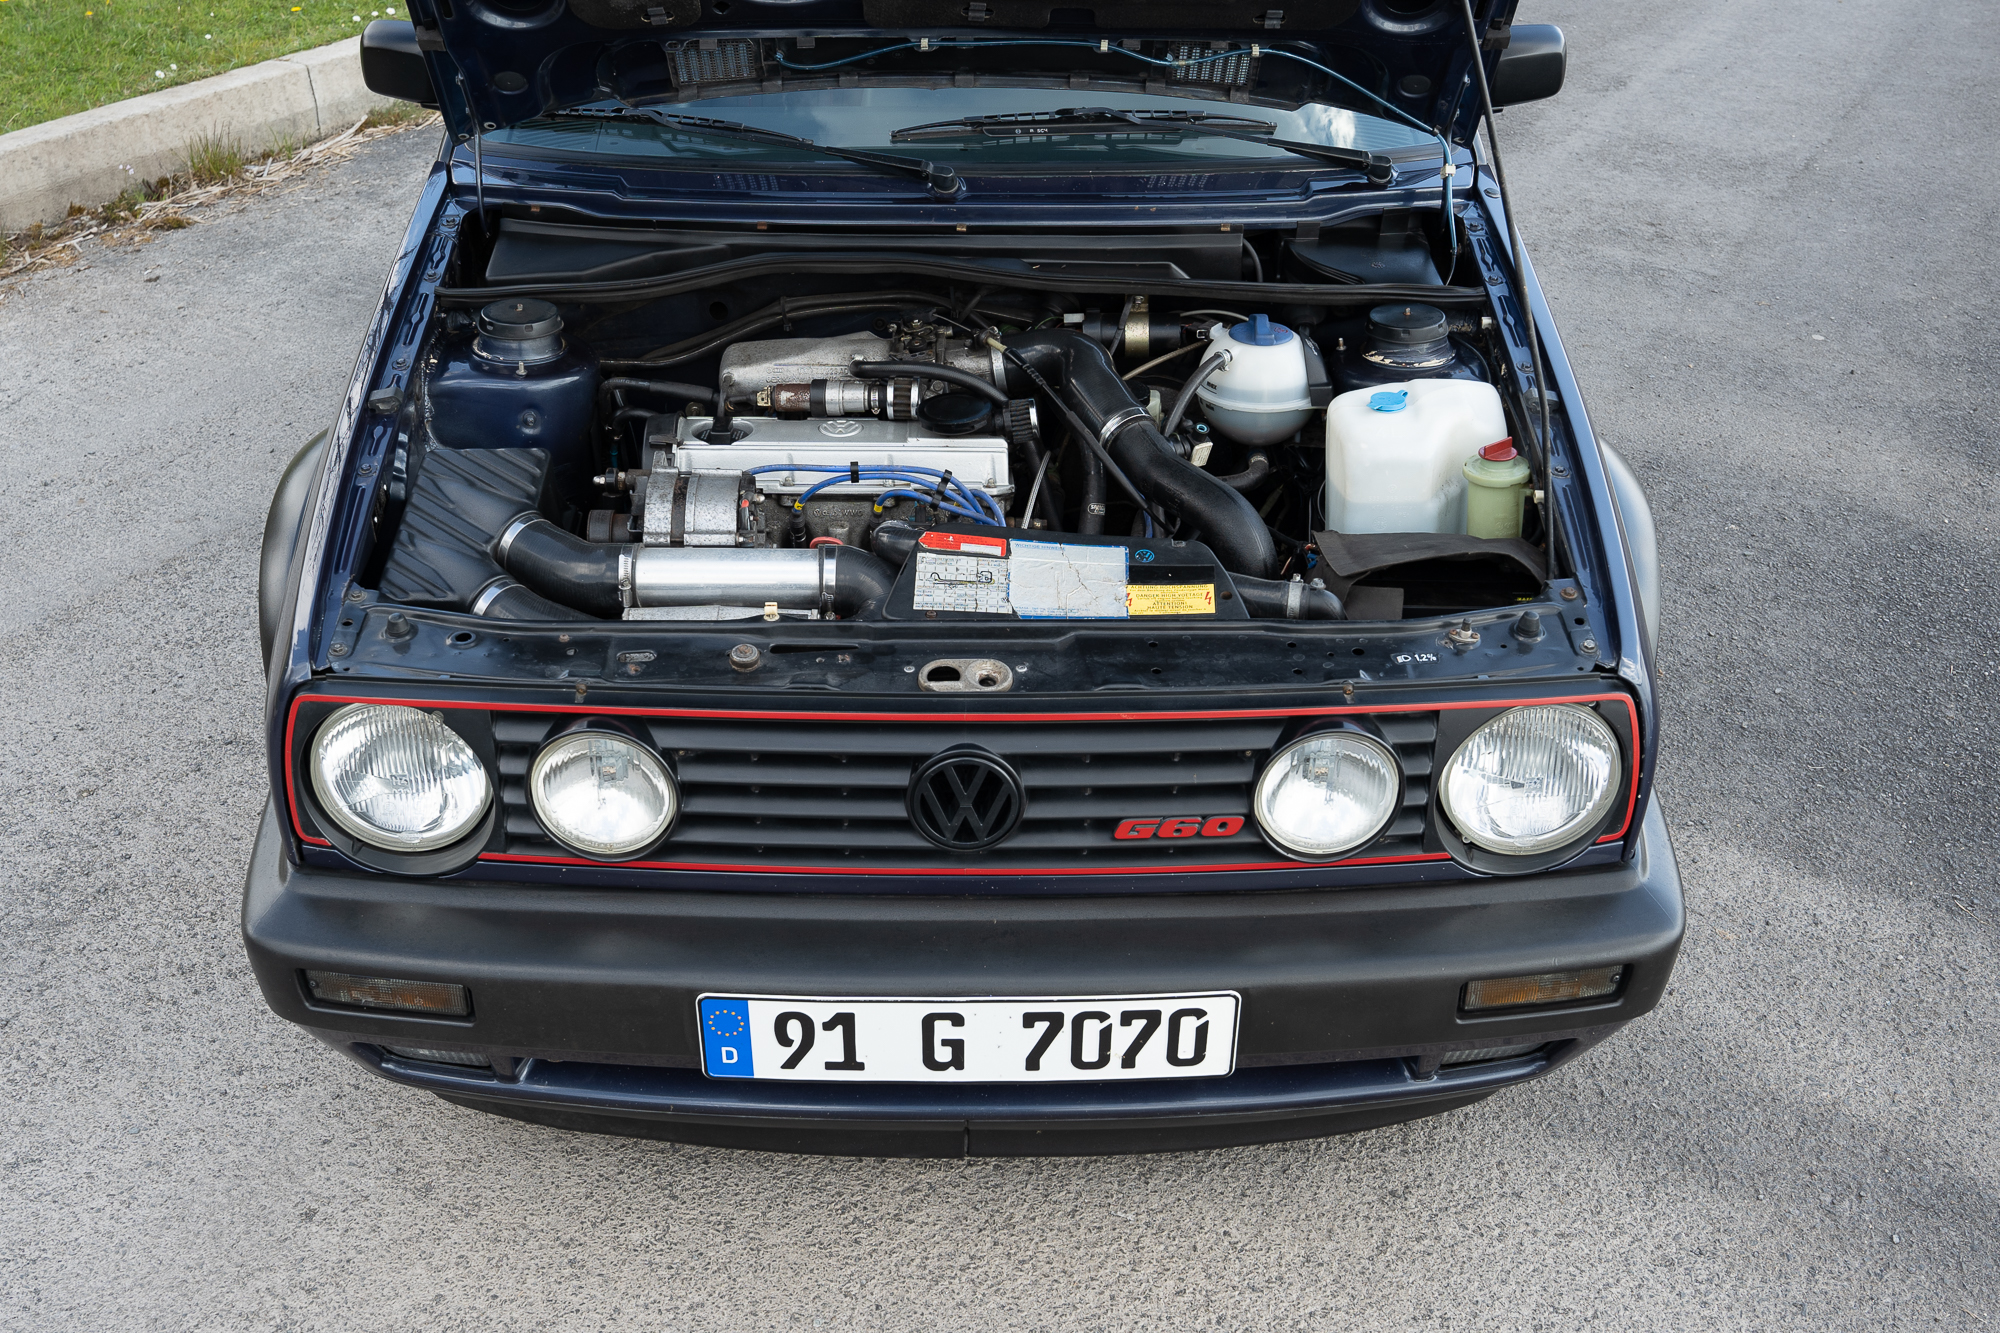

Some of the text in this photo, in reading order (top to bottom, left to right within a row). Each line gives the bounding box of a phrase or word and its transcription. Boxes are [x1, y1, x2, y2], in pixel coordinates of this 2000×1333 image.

[907, 749, 1024, 850] VW
[1113, 815, 1246, 840] G60
[721, 1046, 738, 1064] D
[773, 1007, 1210, 1071] 91 G 7070
